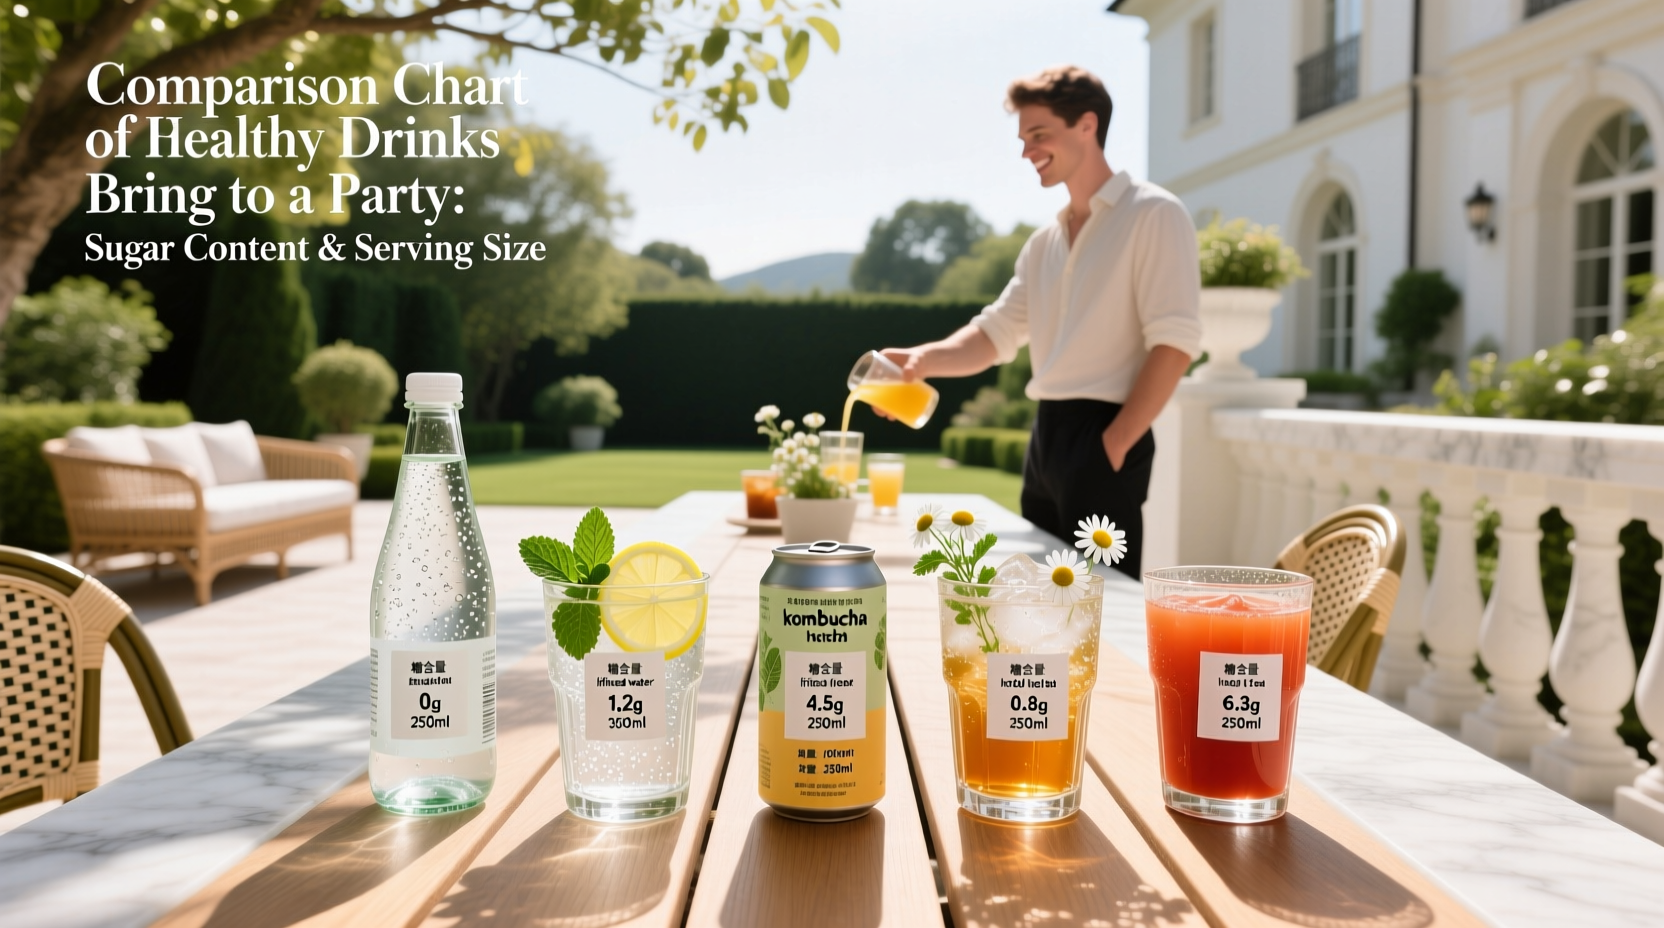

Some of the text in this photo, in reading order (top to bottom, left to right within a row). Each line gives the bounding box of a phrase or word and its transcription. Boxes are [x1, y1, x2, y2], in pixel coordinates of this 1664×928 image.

[783, 608, 868, 627] kombucha
[419, 692, 441, 713] 0g
[608, 694, 643, 715] 1.2g
[806, 694, 844, 715] 4.5g
[1010, 695, 1048, 716] 0.8g
[1222, 694, 1261, 716] 6.3g
[410, 714, 450, 729] 250ml
[807, 715, 846, 729] 250ml
[1009, 716, 1048, 730] 250ml
[1221, 716, 1262, 730] 250ml
